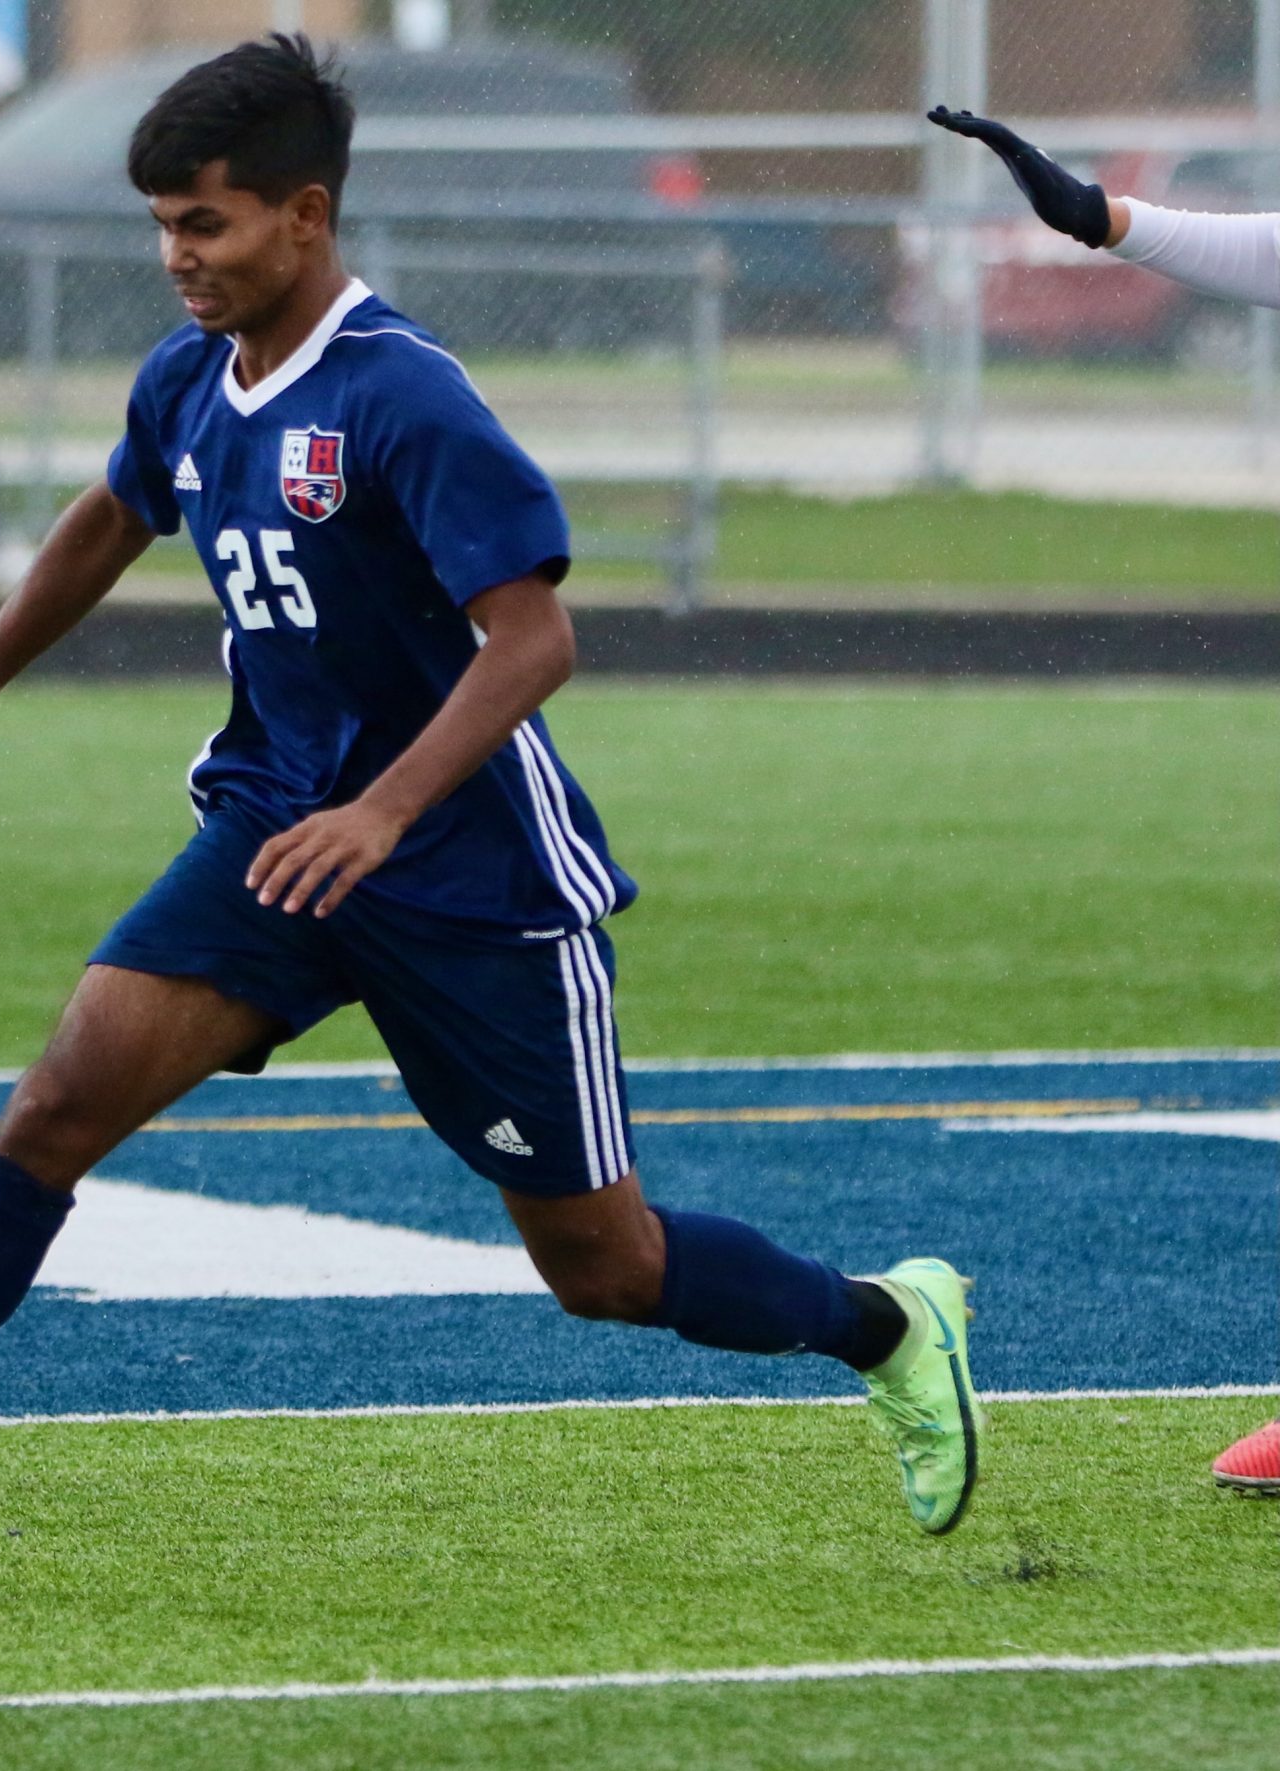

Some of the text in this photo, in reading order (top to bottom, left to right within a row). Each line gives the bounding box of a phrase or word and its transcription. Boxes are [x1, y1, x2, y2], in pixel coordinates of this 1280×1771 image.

[308, 438, 338, 474] H
[216, 529, 318, 630] 25
[485, 1133, 534, 1156] adidas
